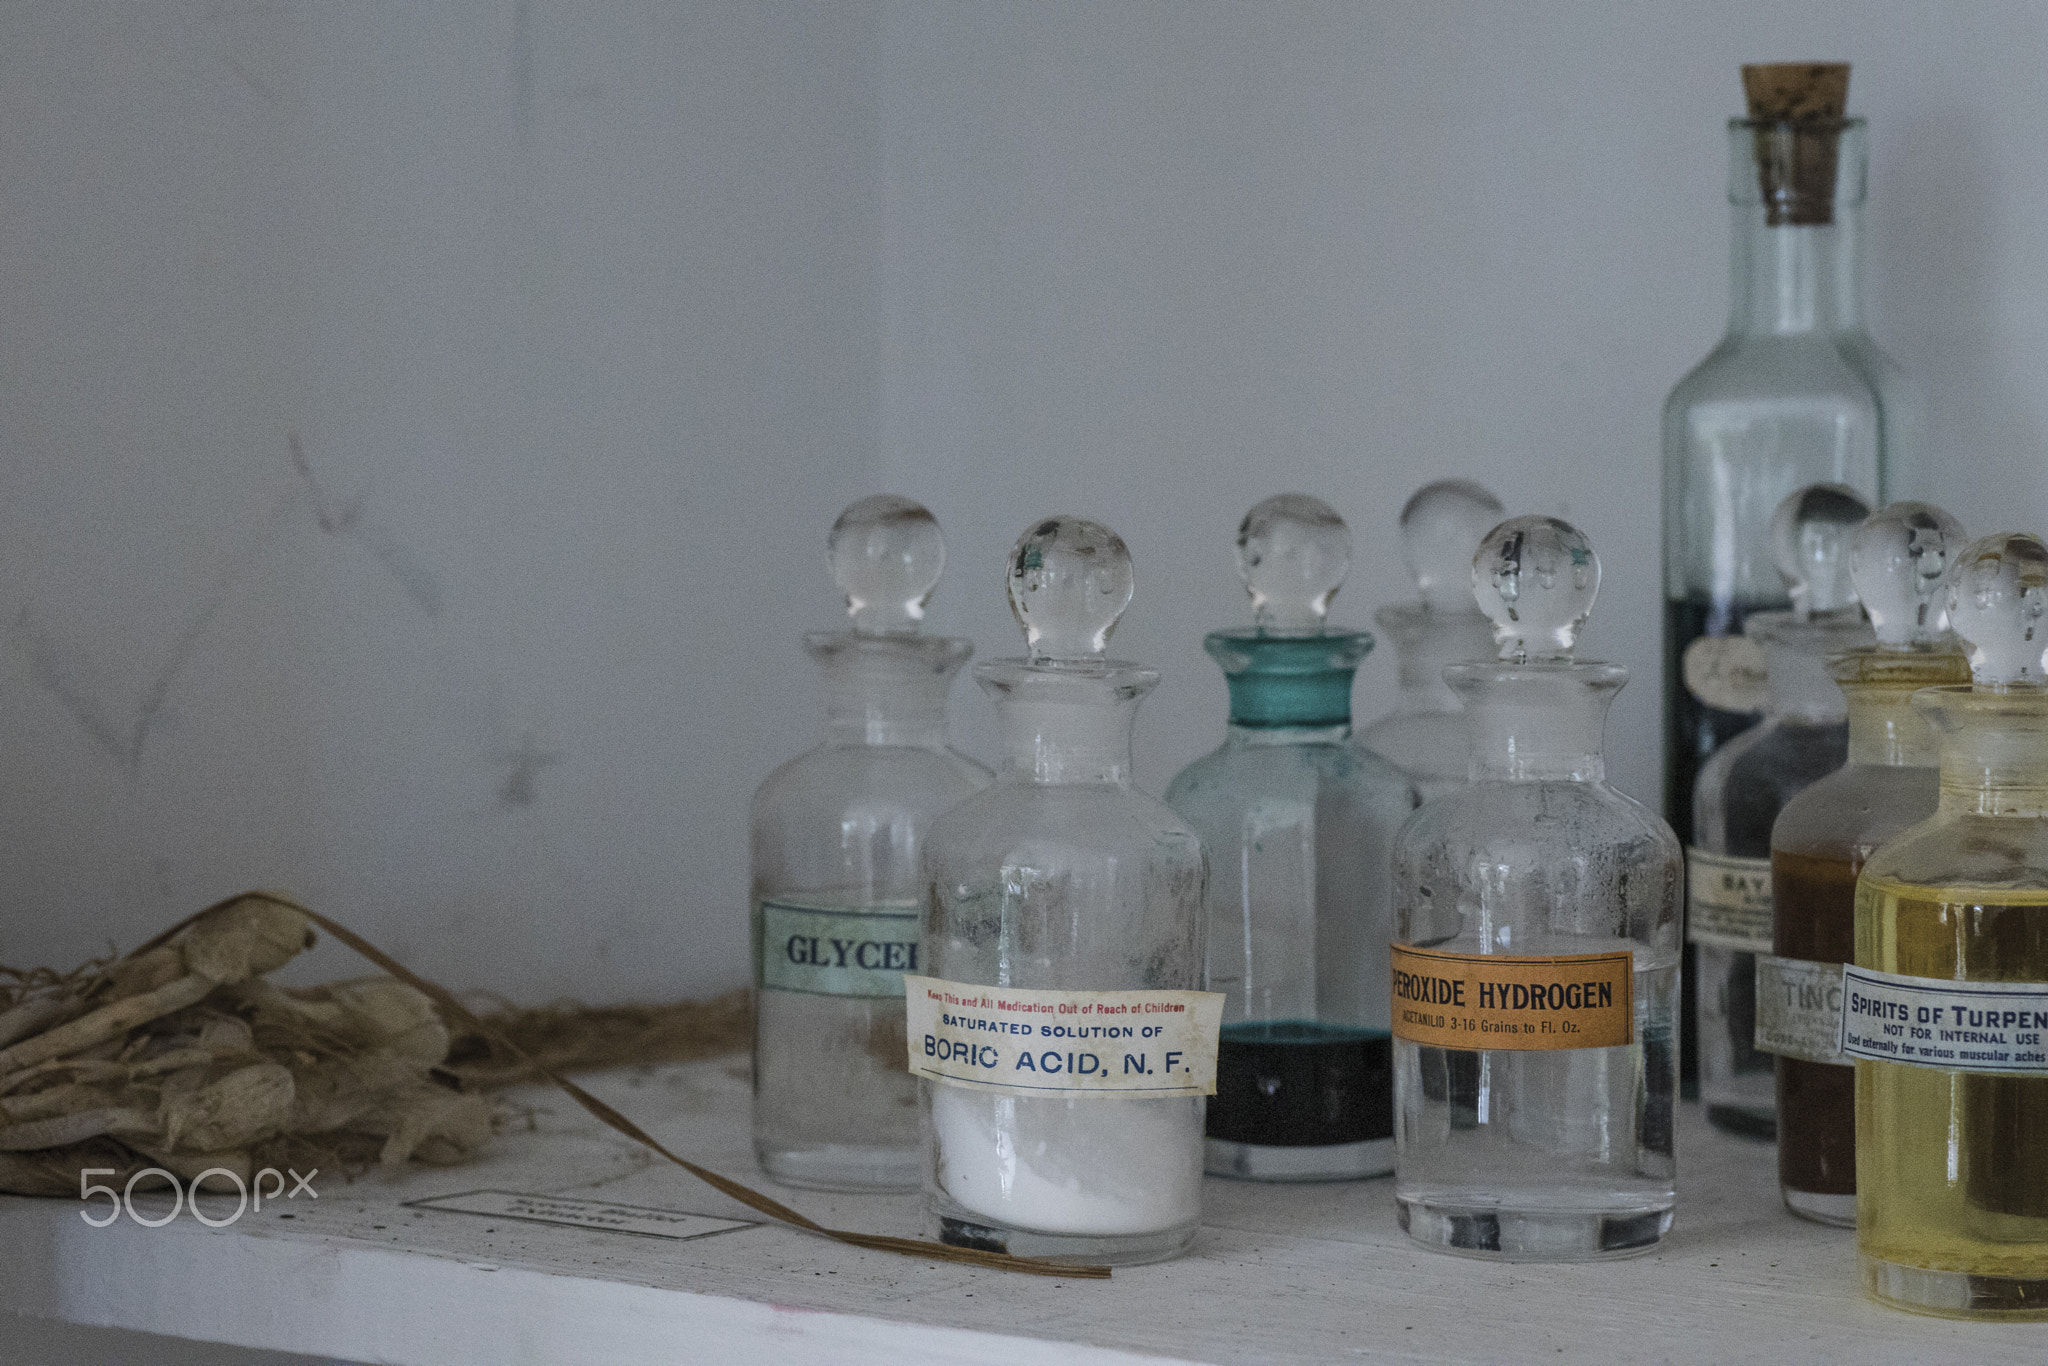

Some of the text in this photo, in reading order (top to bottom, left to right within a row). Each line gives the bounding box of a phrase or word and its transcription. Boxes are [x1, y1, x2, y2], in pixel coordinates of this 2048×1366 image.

[927, 989, 1185, 1014] Keep This and All Medication Out of Reach of Children
[1392, 968, 1612, 1010] PEROXIDE HYDROGEN
[1851, 992, 1909, 1021] SPIRITS
[1917, 1006, 1944, 1024] OF
[942, 1013, 1163, 1038] SATURATED SOLUTION OF
[1451, 1017, 1476, 1031] 3-16
[1481, 1020, 1518, 1034] Grains
[1523, 1022, 1535, 1034] to
[1541, 1021, 1556, 1034] Fl.
[1562, 1021, 1581, 1034] Oz.
[1883, 1023, 2040, 1045] NOT FOR INTERNAL USE
[924, 1034, 1190, 1077] BORIC ACID, N. F.
[1847, 1032, 1861, 1046] Used
[1862, 1037, 1898, 1054] externally
[1902, 1043, 1915, 1055] for
[1919, 1046, 1955, 1059] various
[1959, 1050, 2010, 1062] muscular
[2015, 1051, 2046, 1062] aches
